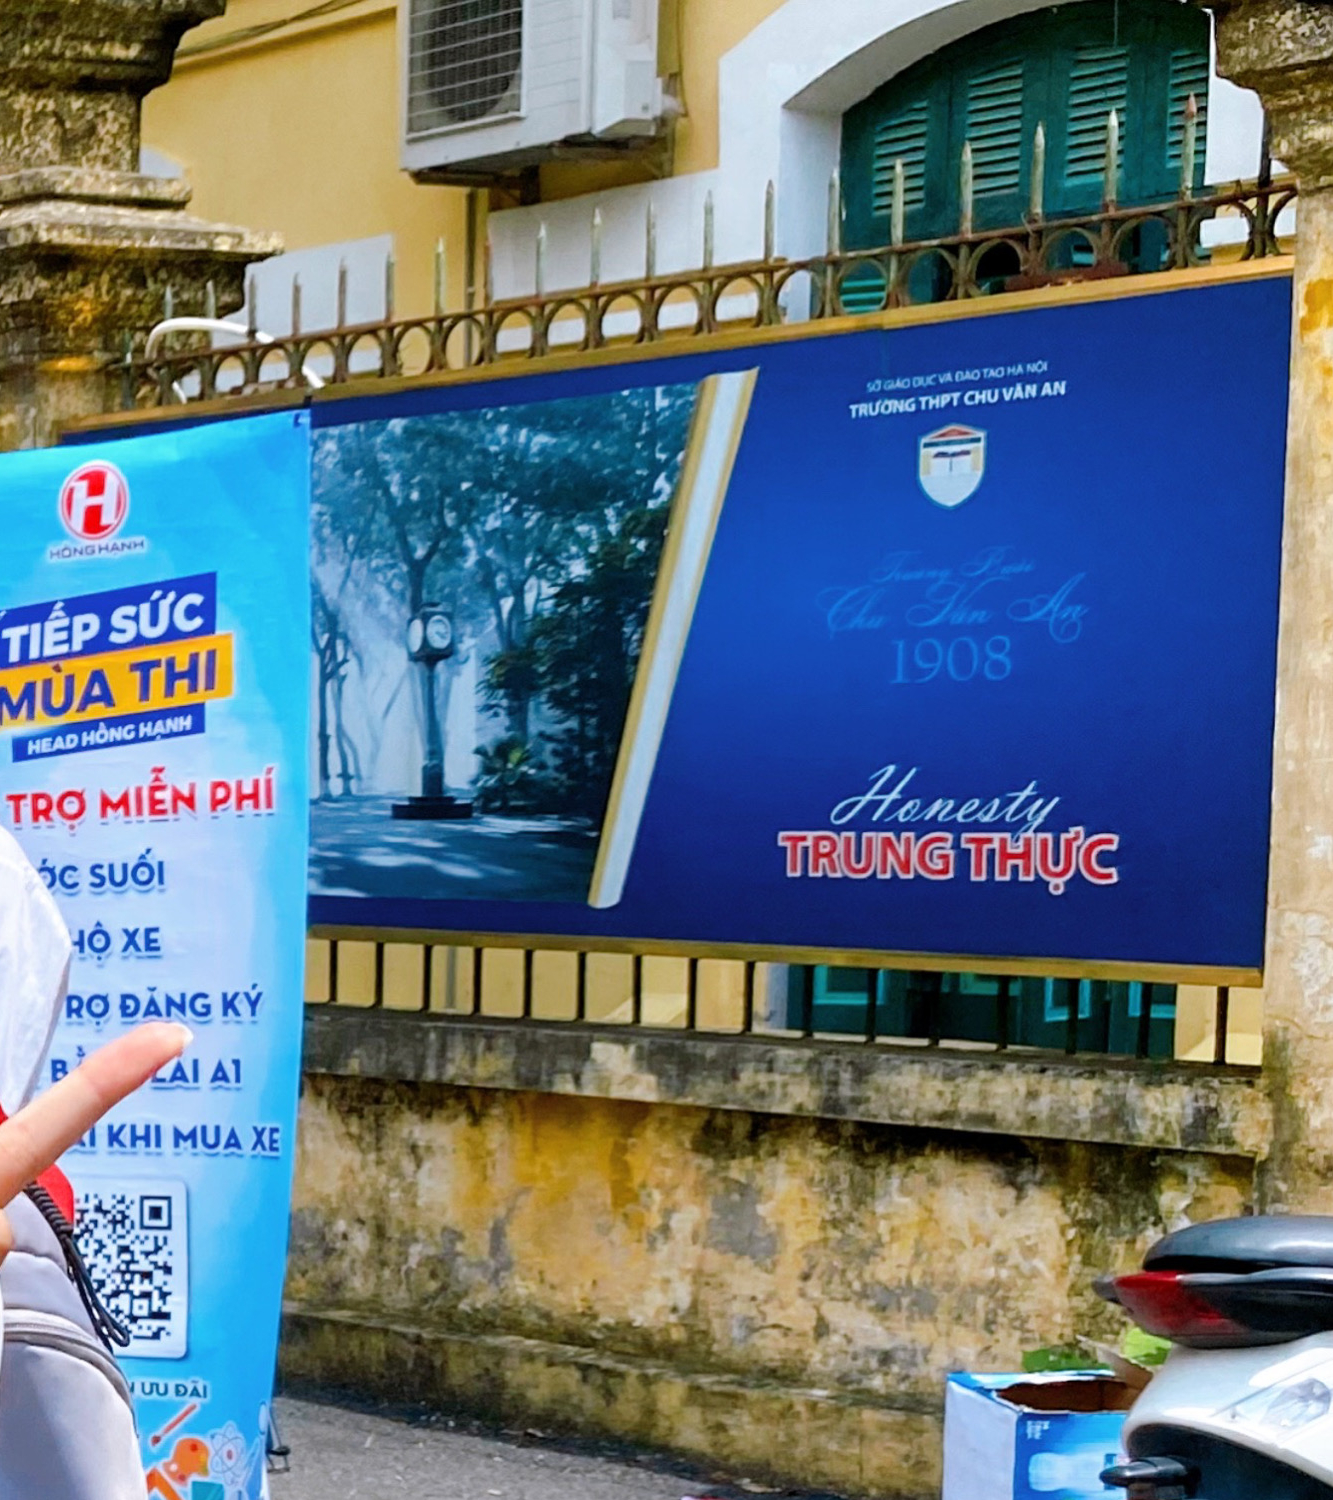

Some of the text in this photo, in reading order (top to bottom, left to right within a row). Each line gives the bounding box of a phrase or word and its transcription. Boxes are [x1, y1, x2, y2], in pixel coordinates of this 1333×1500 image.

[919, 391, 962, 411] THPT
[964, 387, 1000, 407] CHU
[1002, 383, 1038, 402] VĂN
[1040, 380, 1068, 397] AN
[0, 589, 206, 664] TIẾP SỨC
[130, 646, 217, 703] THI
[889, 634, 1013, 685] 1908
[27, 733, 79, 755] HEAD
[5, 787, 87, 831] TRỢ
[99, 766, 196, 819] MIỄN
[209, 766, 275, 814] PHÍ
[829, 763, 1061, 842] Honesty
[89, 848, 165, 889] SUỐI
[777, 826, 1120, 895] TRUNG THỰC
[121, 926, 161, 953] XE
[119, 986, 212, 1019] ĐĂNG
[221, 982, 264, 1018] KÝ
[107, 1124, 163, 1150] KHI
[172, 1124, 243, 1151] MUA
[251, 1125, 281, 1152] XE
